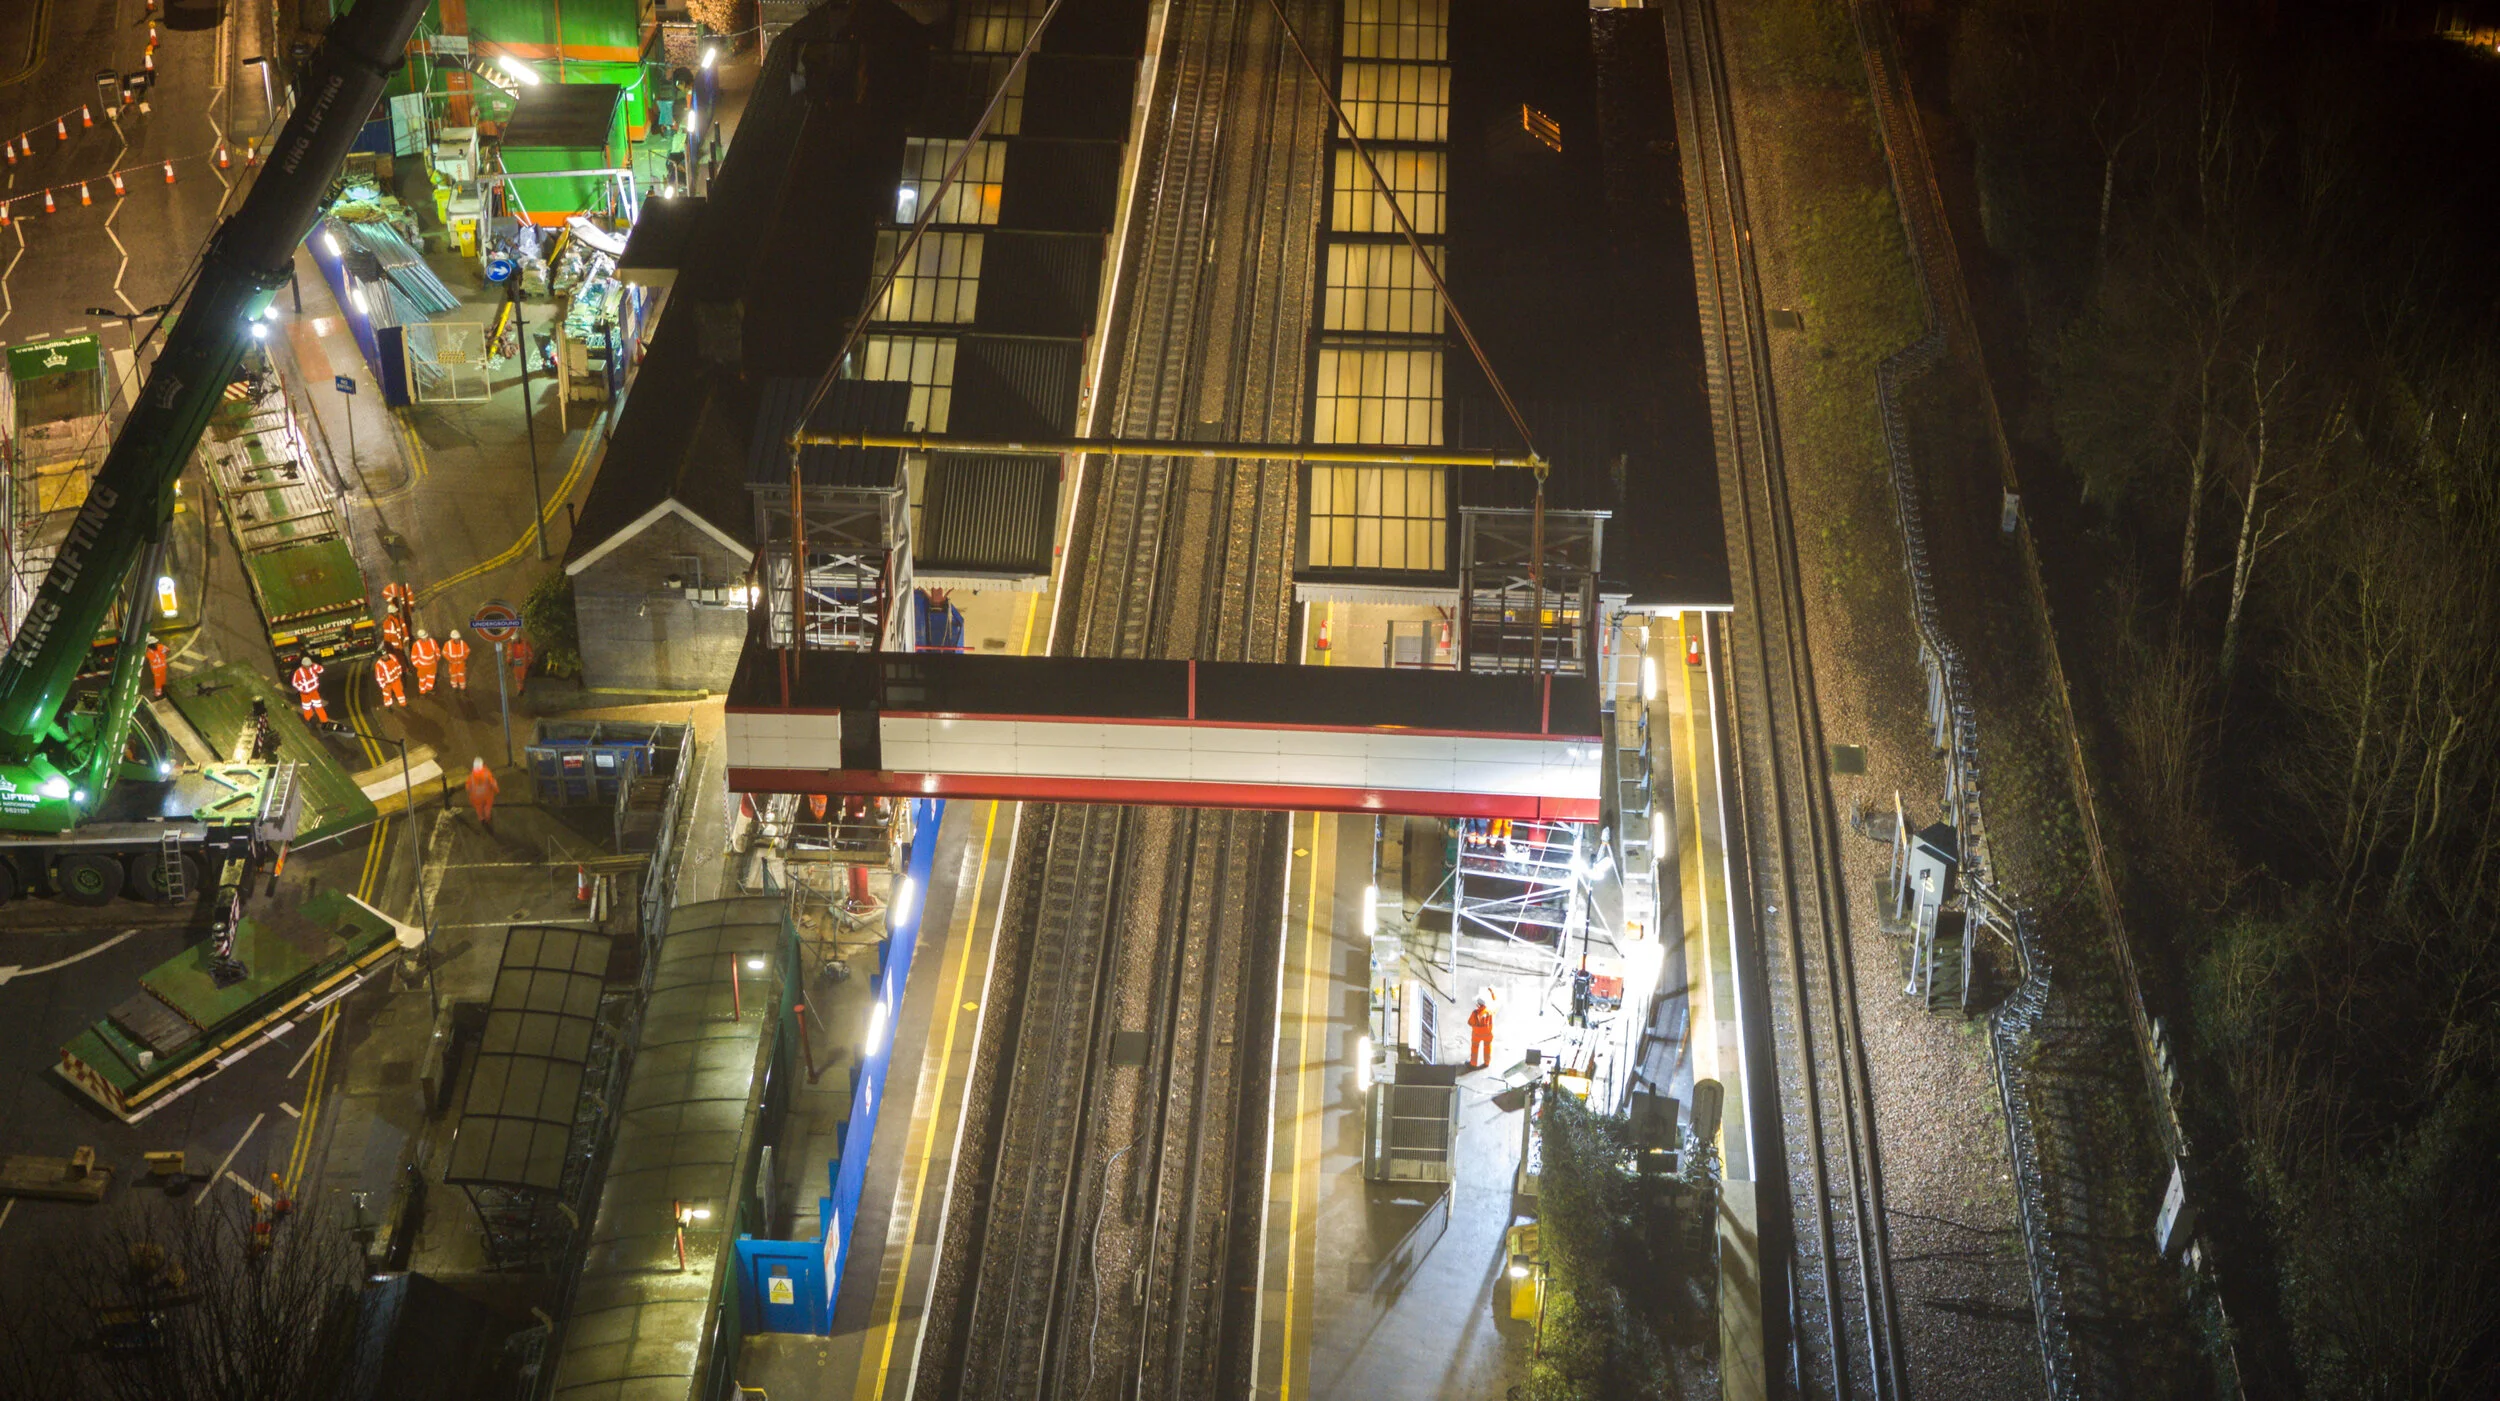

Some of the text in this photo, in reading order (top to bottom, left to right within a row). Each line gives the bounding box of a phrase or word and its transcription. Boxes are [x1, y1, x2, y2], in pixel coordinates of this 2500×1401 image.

[10, 483, 119, 668] KING LIFTING
[294, 625, 317, 636] KING
[318, 617, 353, 631] LIFTING
[472, 620, 520, 628] UNDERGROUND
[1, 792, 40, 803] LIFTING
